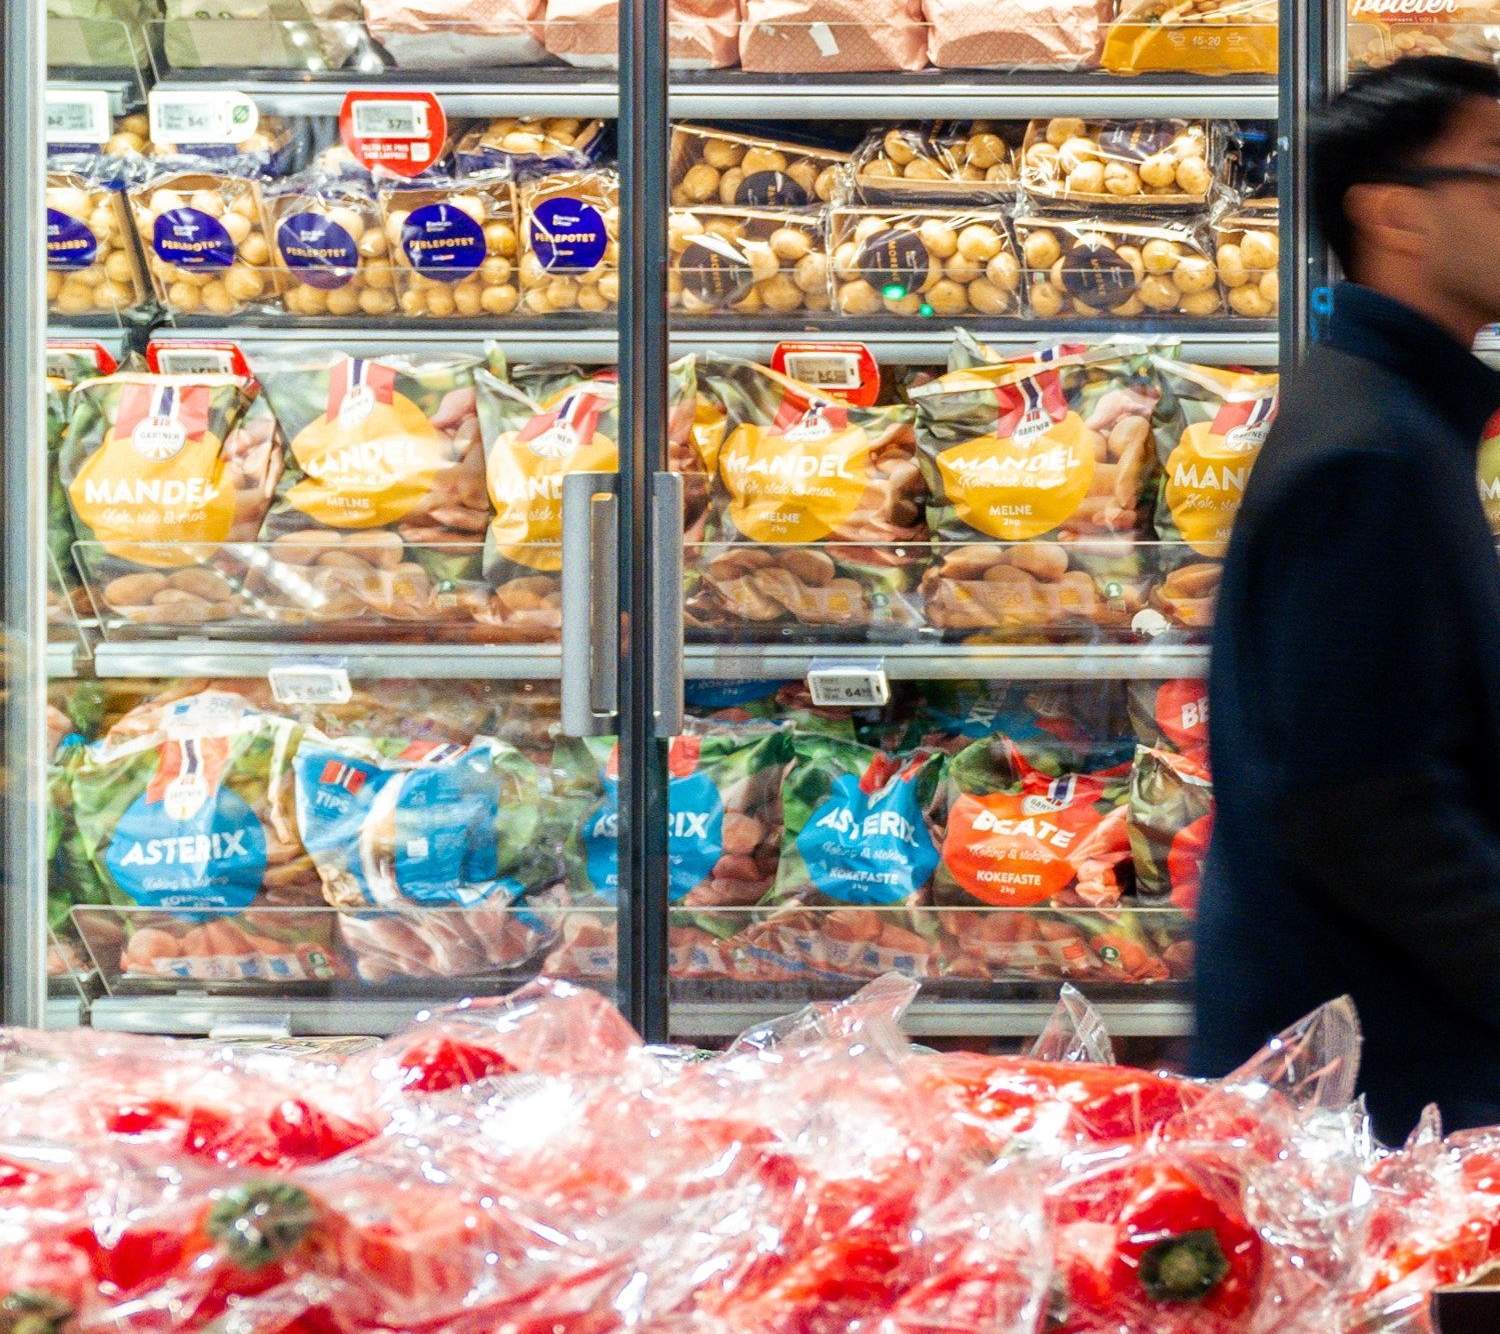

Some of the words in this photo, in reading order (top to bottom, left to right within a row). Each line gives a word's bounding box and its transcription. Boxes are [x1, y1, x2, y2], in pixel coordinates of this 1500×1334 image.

[84, 476, 221, 505] MANDEL
[989, 503, 1033, 516] MELNE
[971, 812, 1076, 848] BEATE
[120, 829, 248, 867] ASTERIX
[975, 867, 1041, 886] KOKEFASTE
